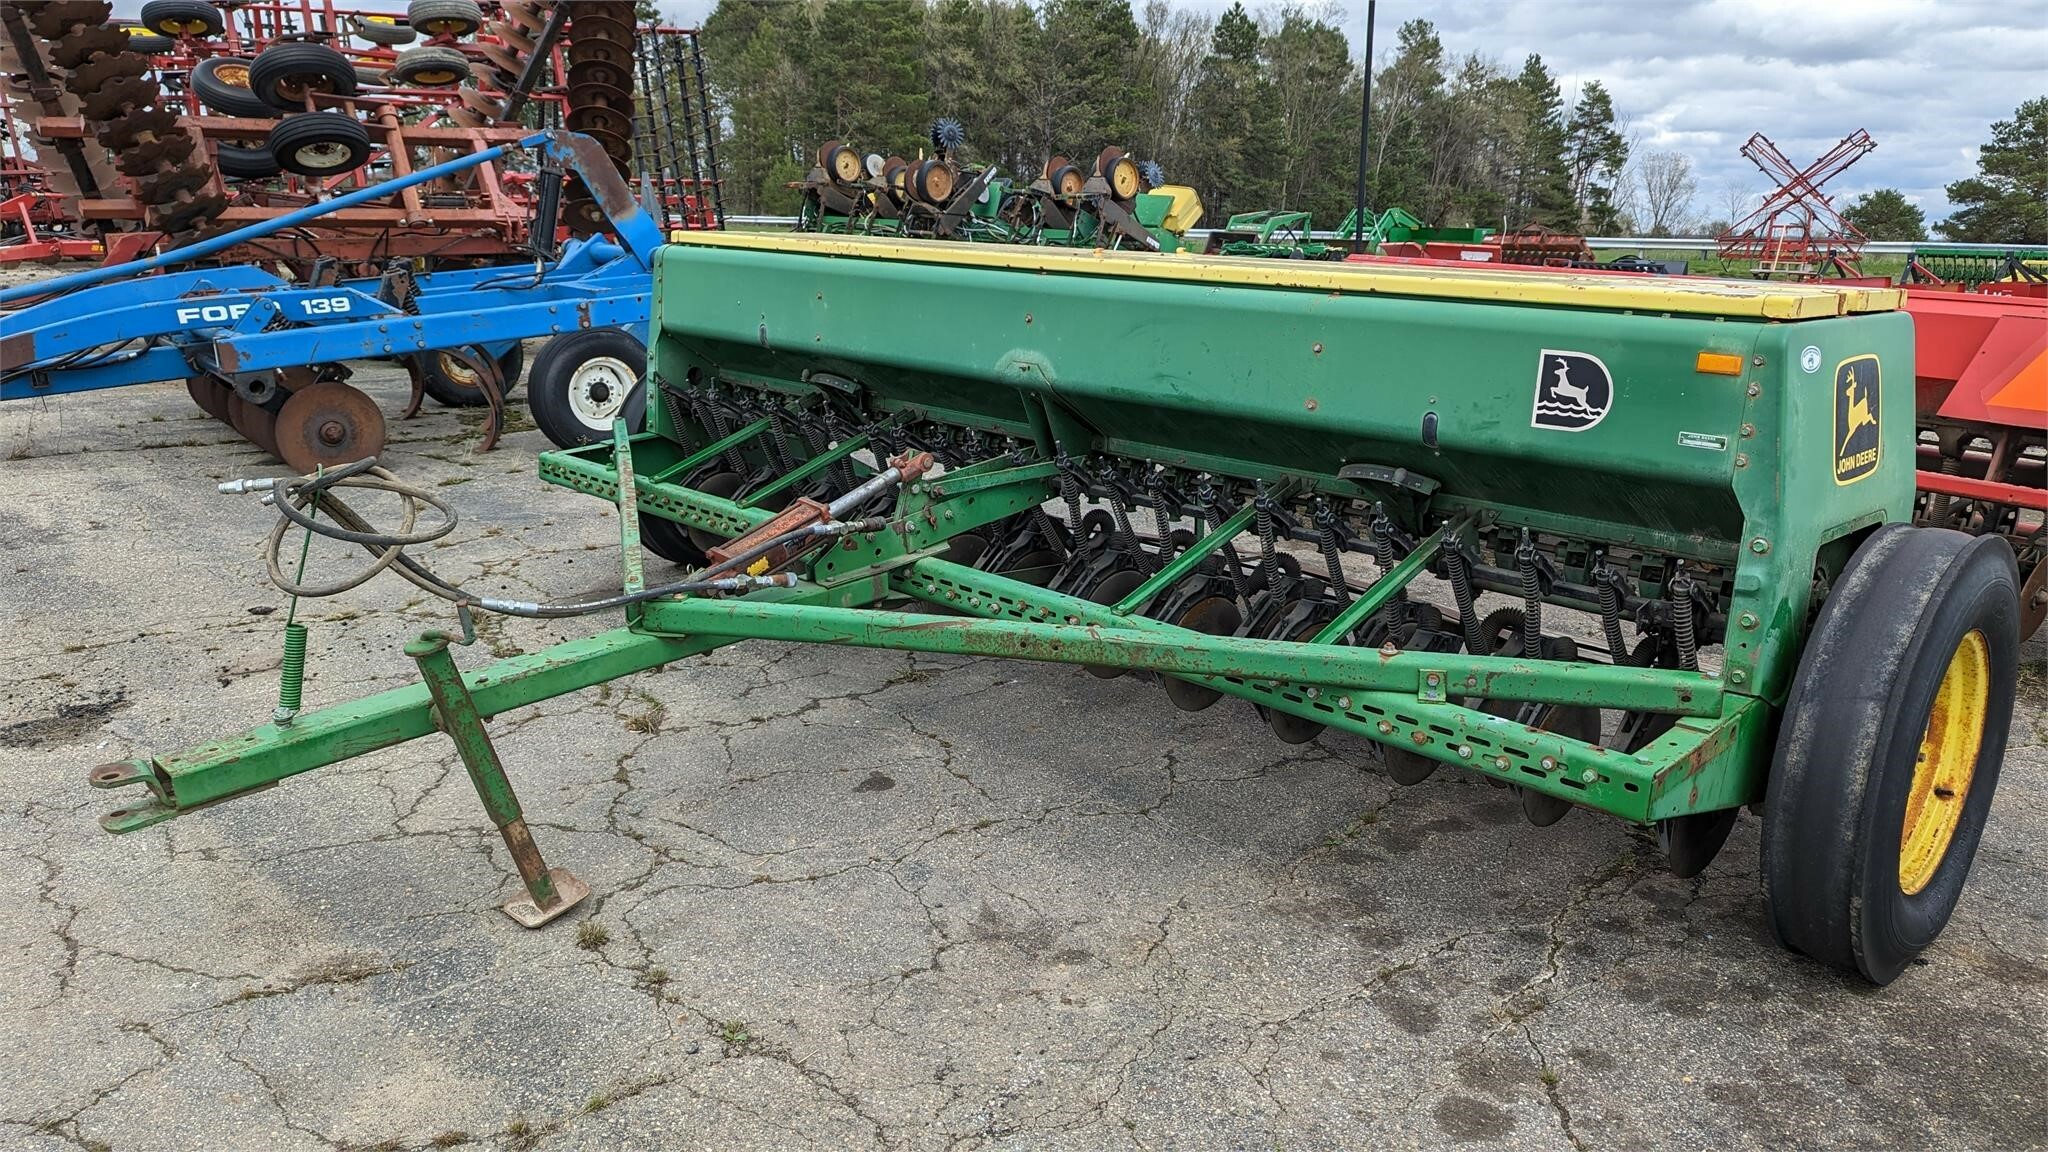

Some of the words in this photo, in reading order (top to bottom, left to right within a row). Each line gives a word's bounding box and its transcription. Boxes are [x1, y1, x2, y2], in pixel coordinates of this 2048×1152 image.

[177, 301, 281, 324] FOR
[300, 296, 351, 315] 139
[1837, 454, 1856, 474] JOHN
[1856, 447, 1877, 468] DEERE
